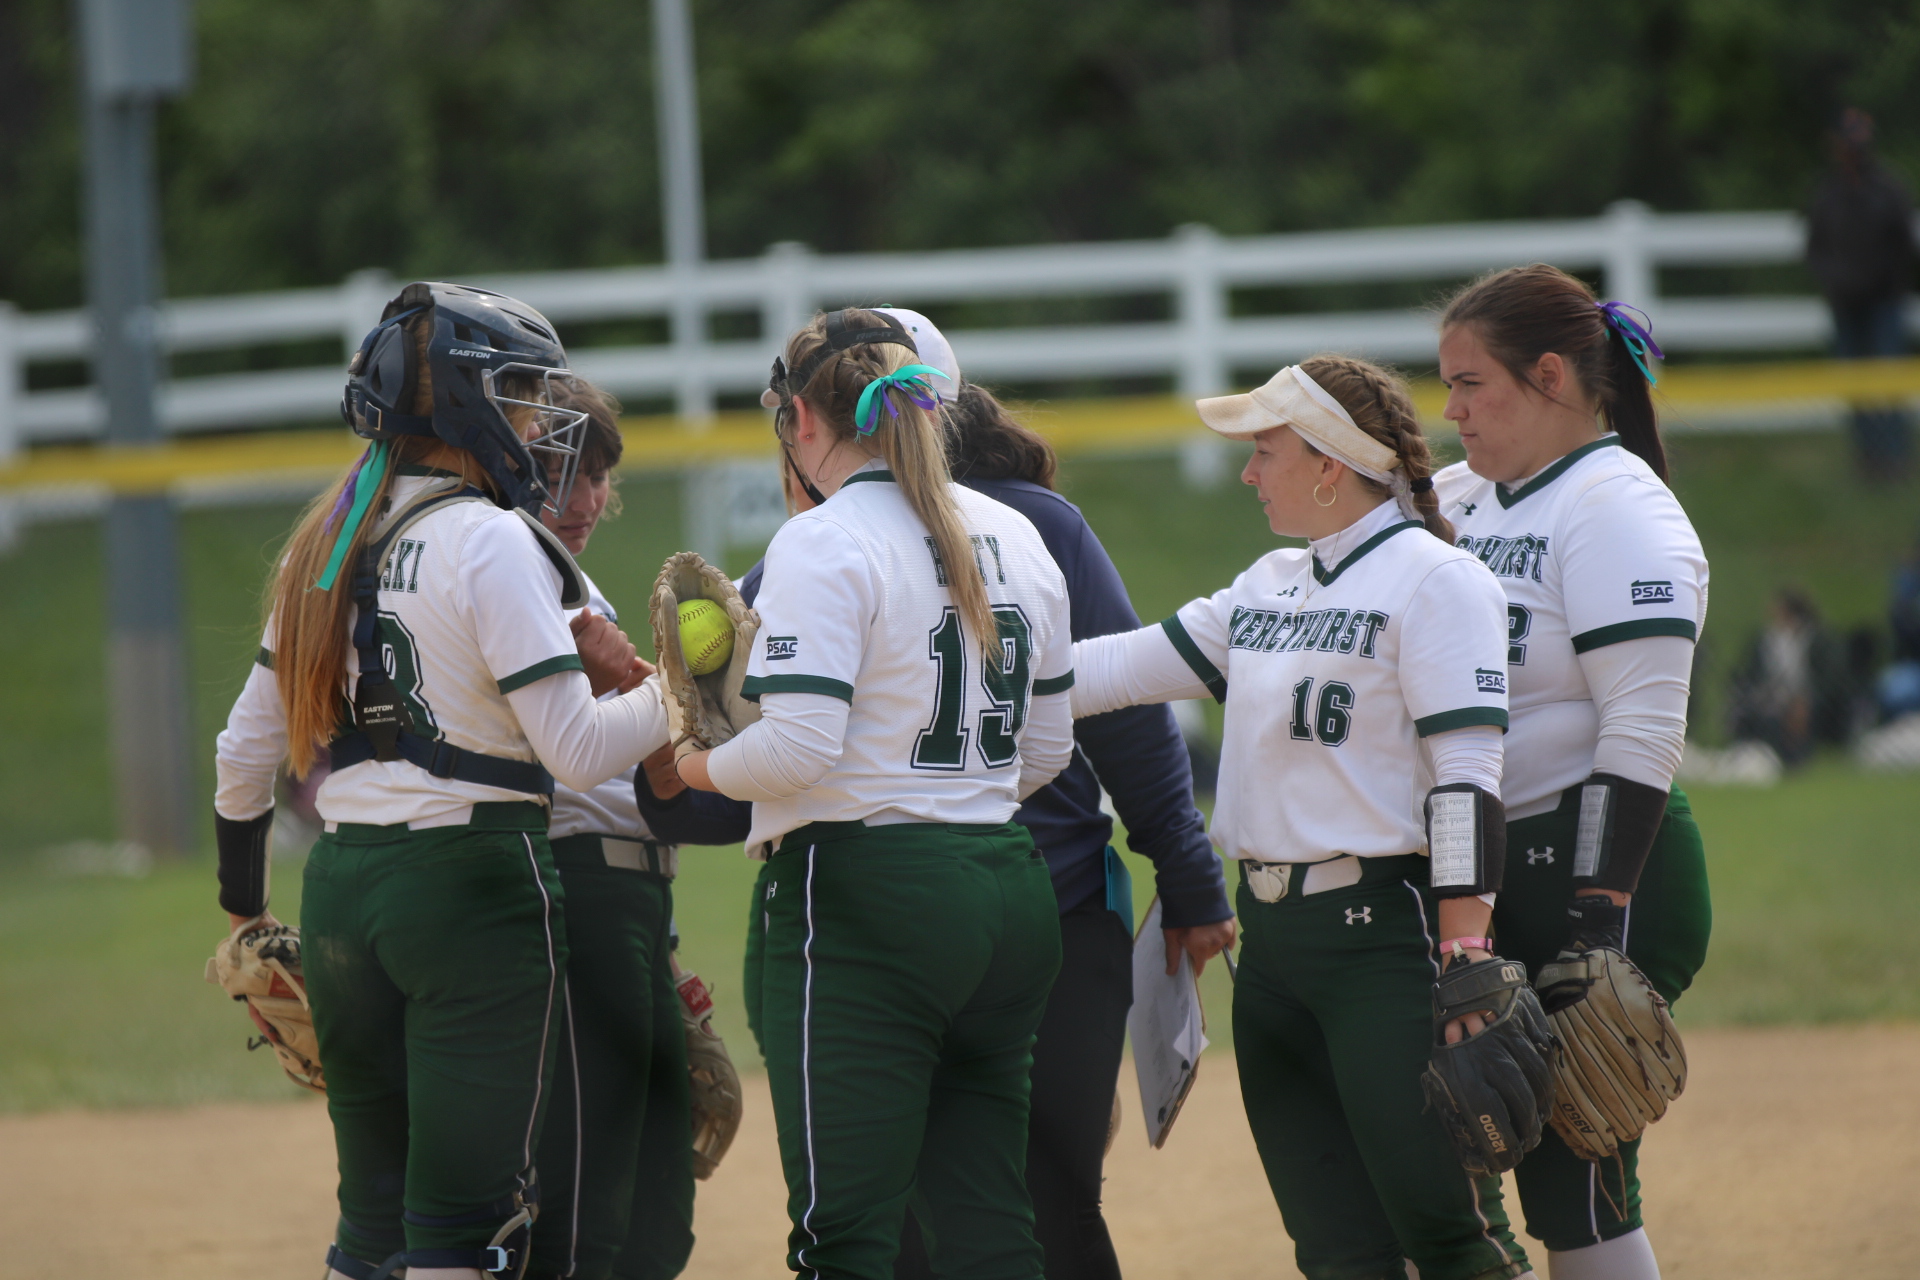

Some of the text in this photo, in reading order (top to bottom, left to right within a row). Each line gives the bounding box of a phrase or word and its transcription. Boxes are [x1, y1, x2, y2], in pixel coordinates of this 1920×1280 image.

[449, 348, 491, 359] EASTON
[1631, 586, 1674, 599] PSAC
[767, 641, 798, 655] PSAC
[910, 603, 1032, 771] 19
[1476, 674, 1506, 689] PSAC
[363, 704, 394, 714] EASTON
[1289, 676, 1356, 747] 16
[1562, 1103, 1595, 1134] A950
[1479, 1114, 1508, 1154] A2000
